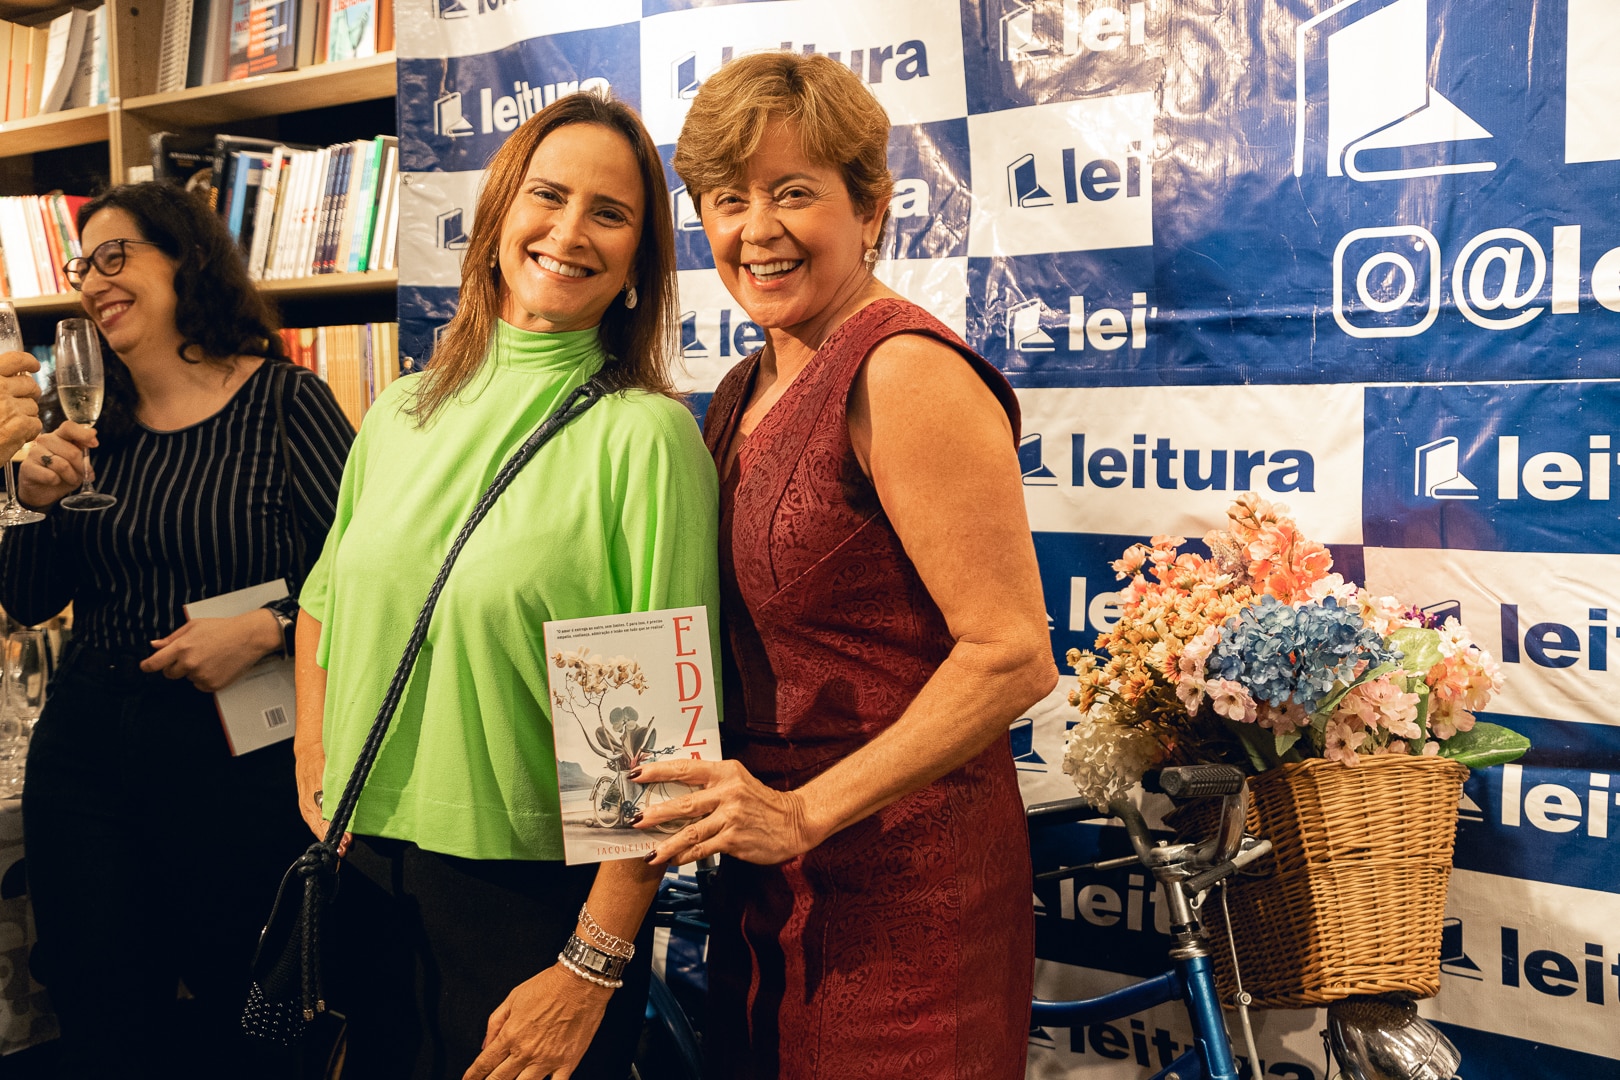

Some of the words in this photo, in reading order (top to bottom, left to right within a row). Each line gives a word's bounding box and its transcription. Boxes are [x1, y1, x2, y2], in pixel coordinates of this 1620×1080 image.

[1062, 140, 1141, 204] lei
[1068, 292, 1158, 351] lei
[1071, 433, 1316, 493] leitura
[1498, 435, 1620, 501] lei
[1500, 603, 1620, 671] lei
[1502, 763, 1620, 838] lei
